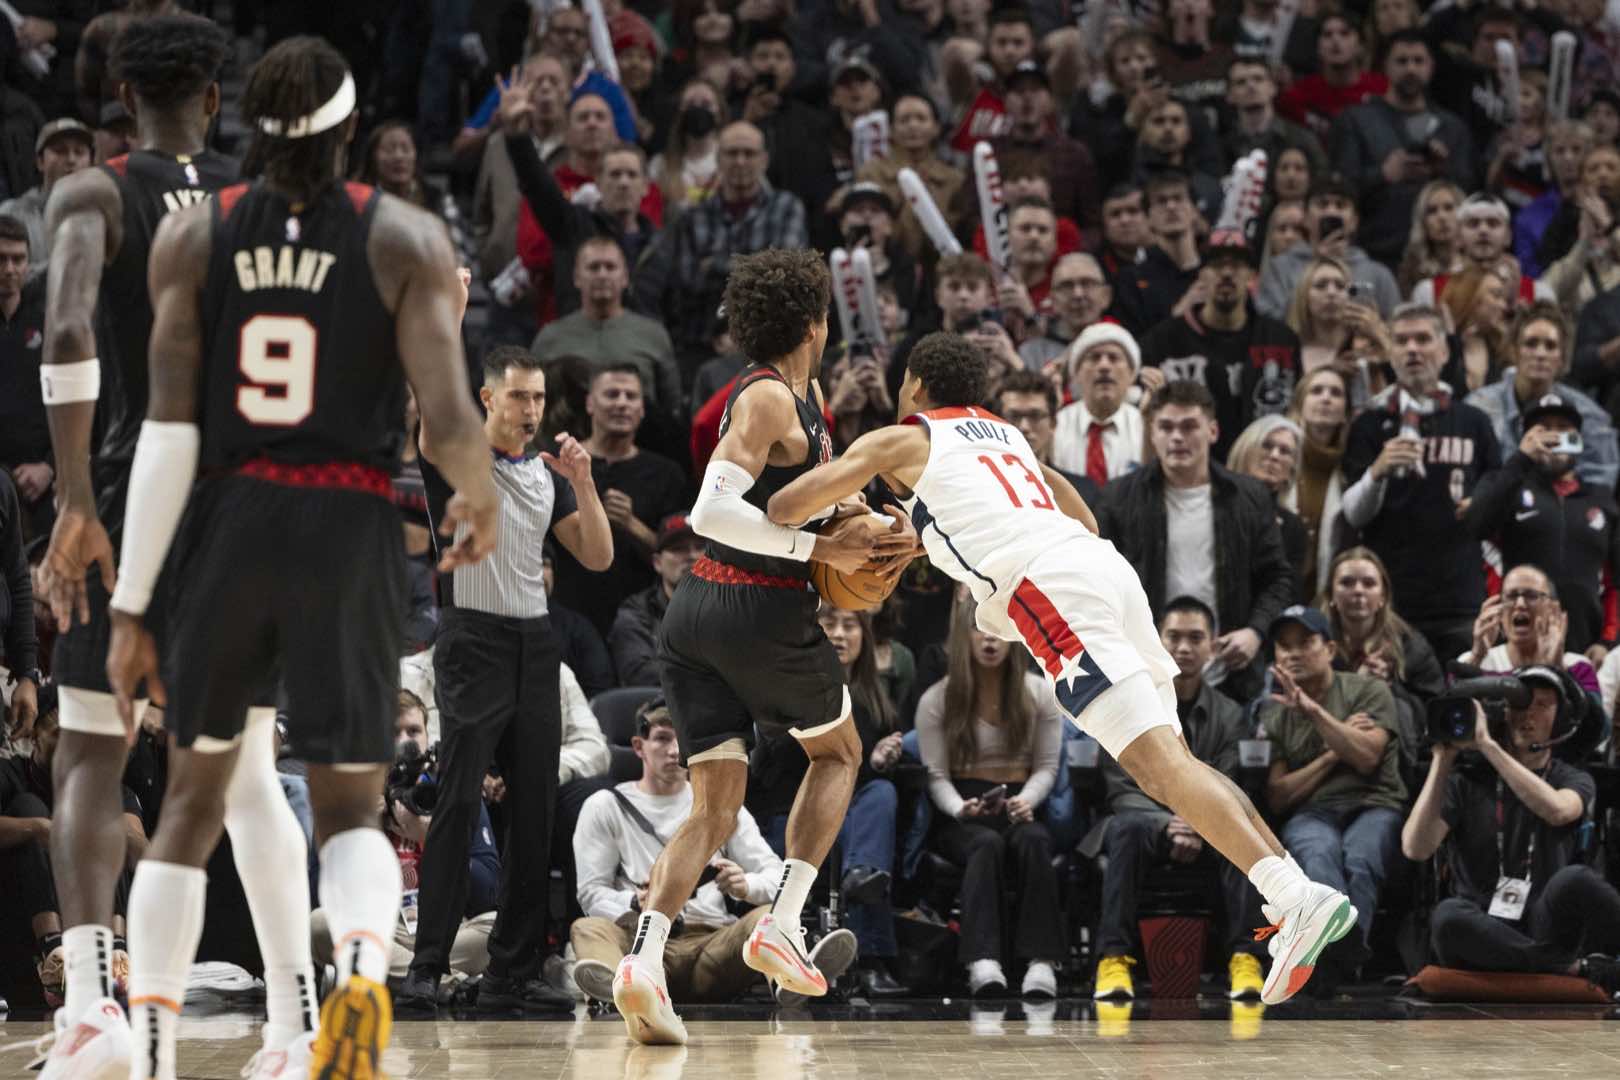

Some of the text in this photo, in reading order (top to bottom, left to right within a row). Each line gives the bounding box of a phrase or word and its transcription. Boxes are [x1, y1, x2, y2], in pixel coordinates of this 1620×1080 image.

[234, 246, 337, 294] GRANT
[236, 314, 317, 427] 9
[954, 421, 1011, 446] POOLE
[977, 453, 1055, 511] 13
